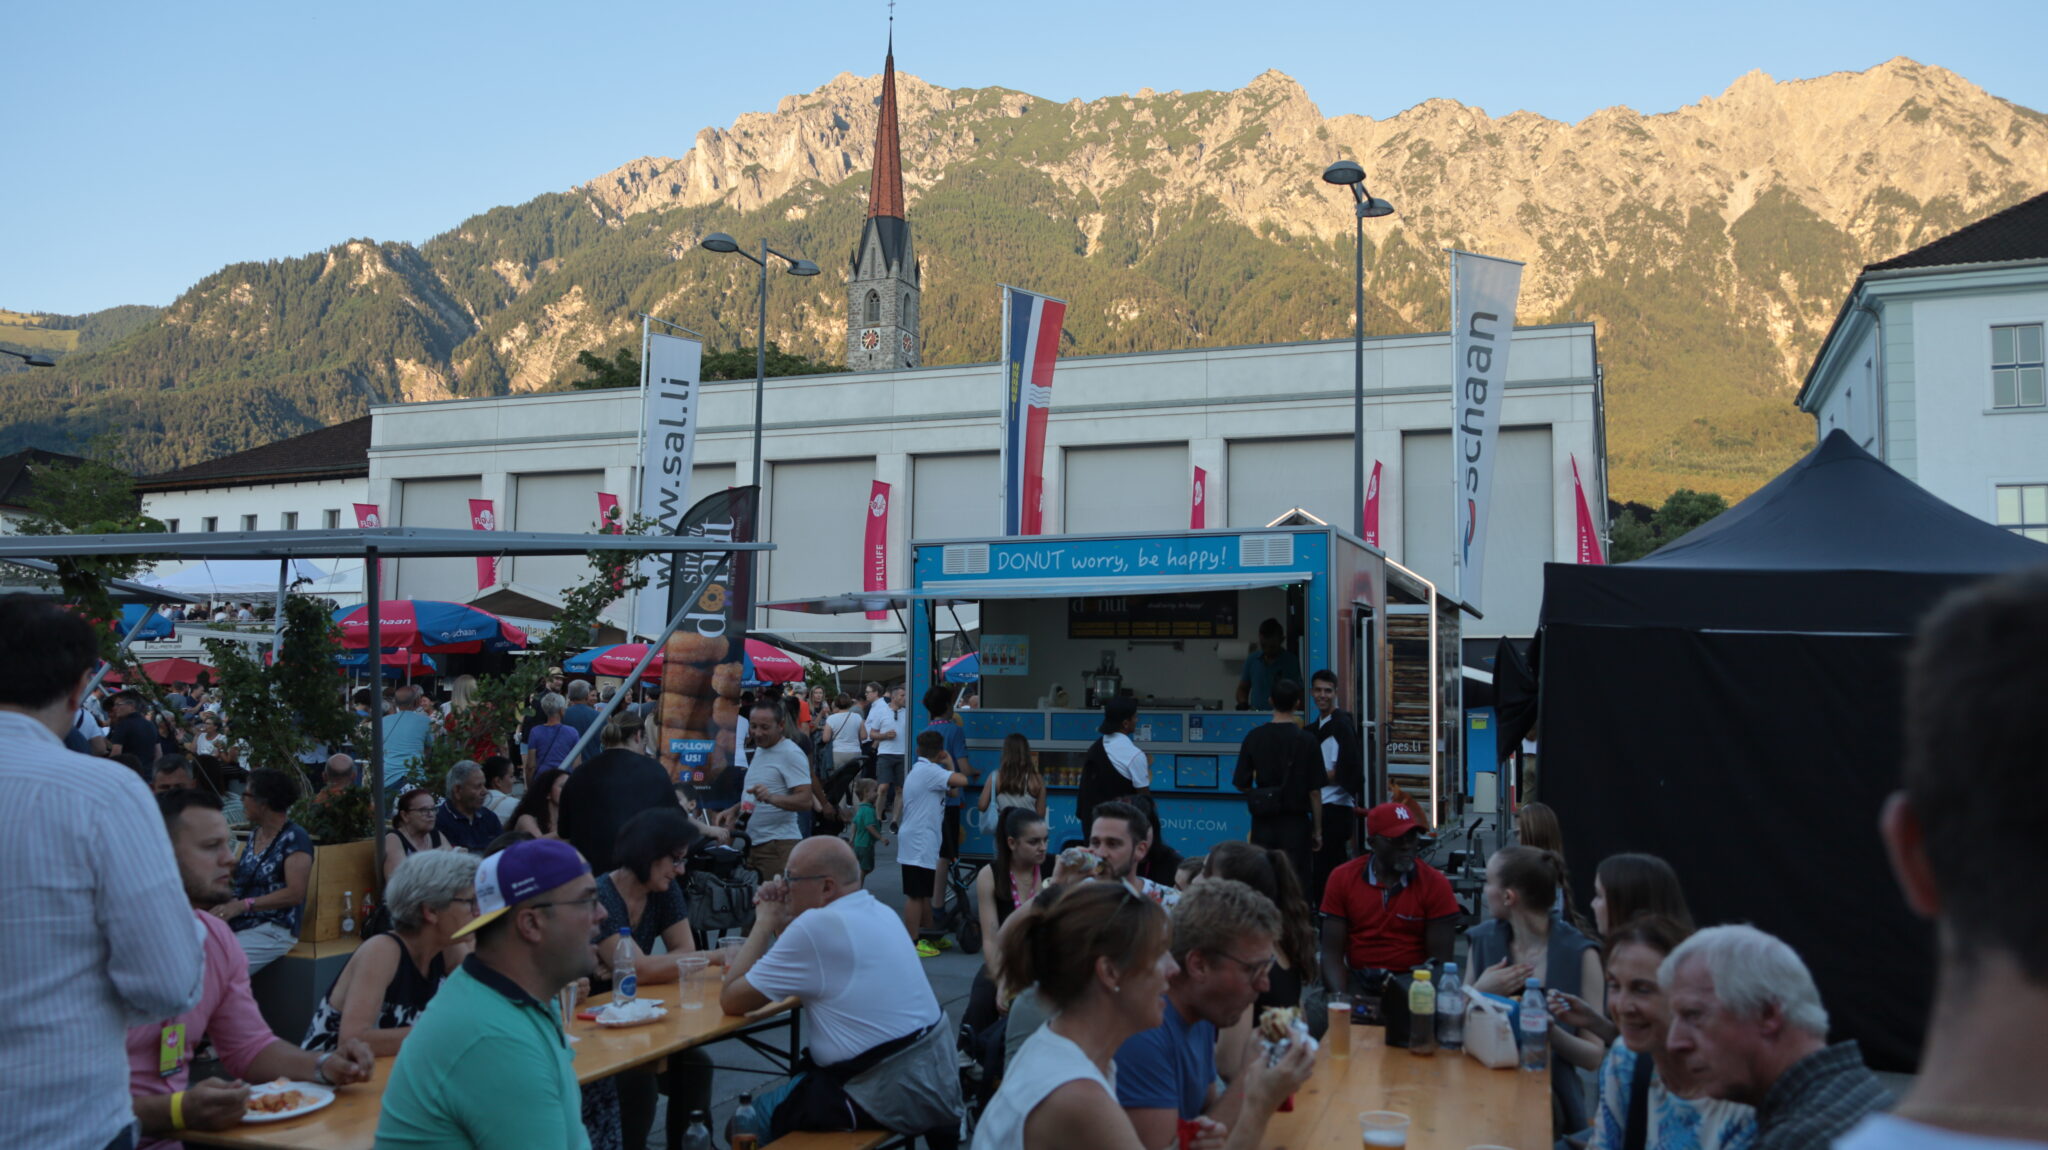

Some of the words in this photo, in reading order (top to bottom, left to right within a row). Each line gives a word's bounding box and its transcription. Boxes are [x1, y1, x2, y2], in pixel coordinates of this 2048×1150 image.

[1460, 311, 1498, 493] schaan
[997, 549, 1065, 572] DONUT
[1071, 555, 1129, 573] worry,
[1138, 547, 1159, 567] be
[1167, 546, 1227, 571] happy!
[671, 742, 713, 751] FOLLOW
[1386, 740, 1421, 754] epes.li
[685, 753, 702, 762] US!
[1159, 817, 1228, 832] ONUT.COM
